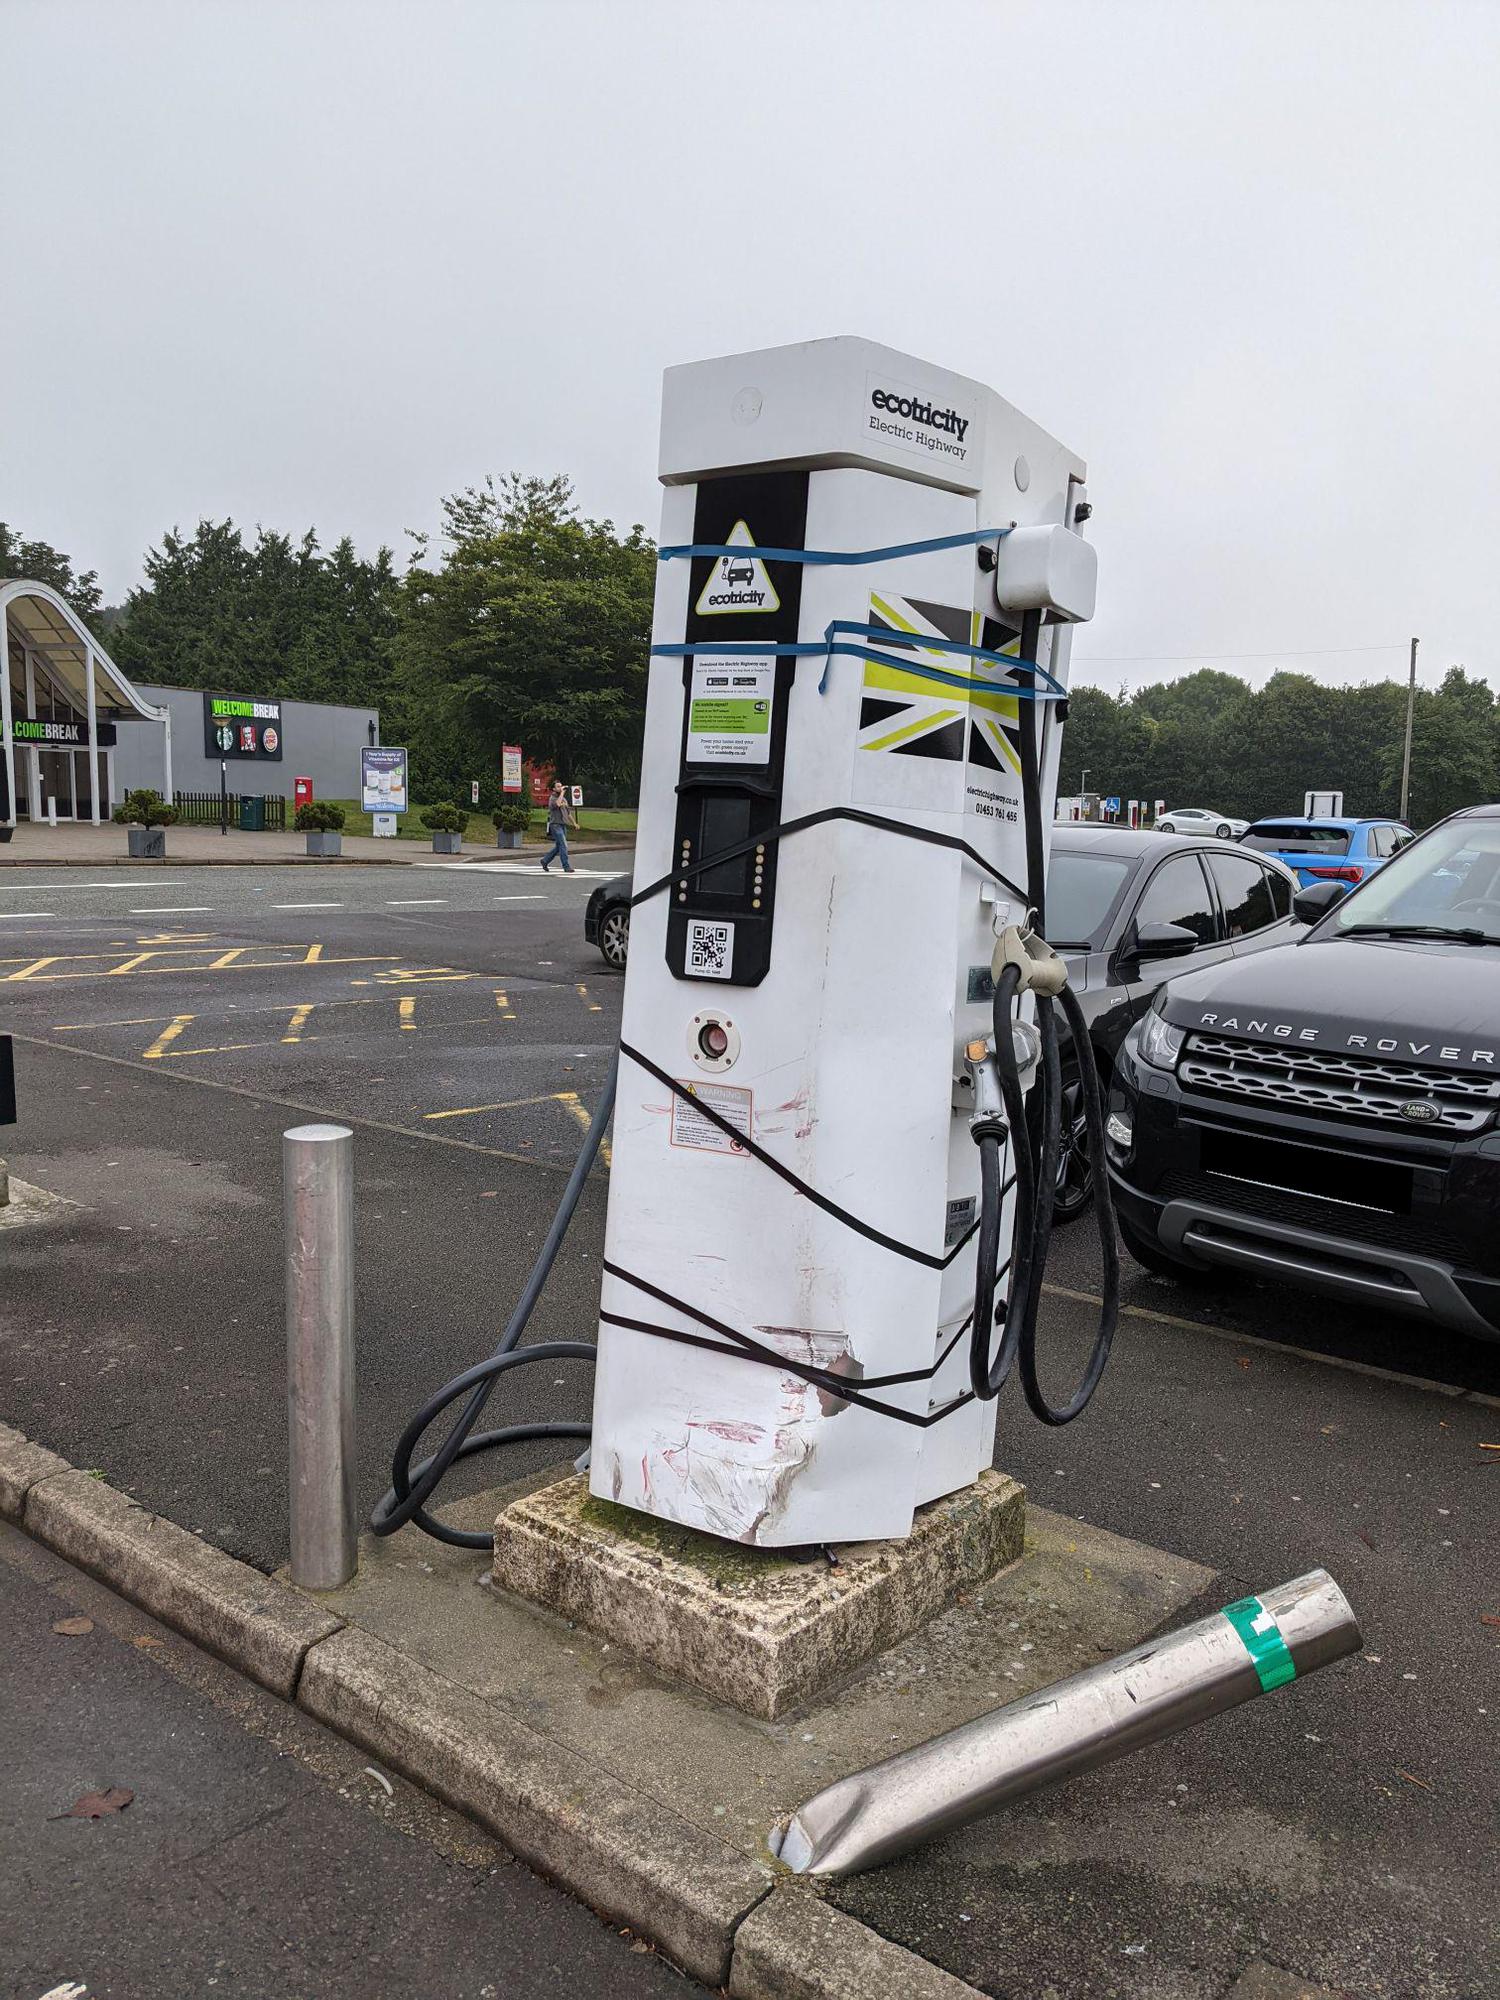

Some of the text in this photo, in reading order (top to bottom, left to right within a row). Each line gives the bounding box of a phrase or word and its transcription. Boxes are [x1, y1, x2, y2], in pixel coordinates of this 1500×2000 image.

[872, 389, 969, 442] ecotricity
[869, 416, 967, 460] Electric Highway
[709, 590, 765, 606] ecotricity
[967, 786, 1019, 807] electrichighway.co.uk
[975, 803, 1018, 822] 01453 761 455
[1200, 1013, 1495, 1064] RANGE ROVER
[701, 1087, 742, 1100] WARNING
